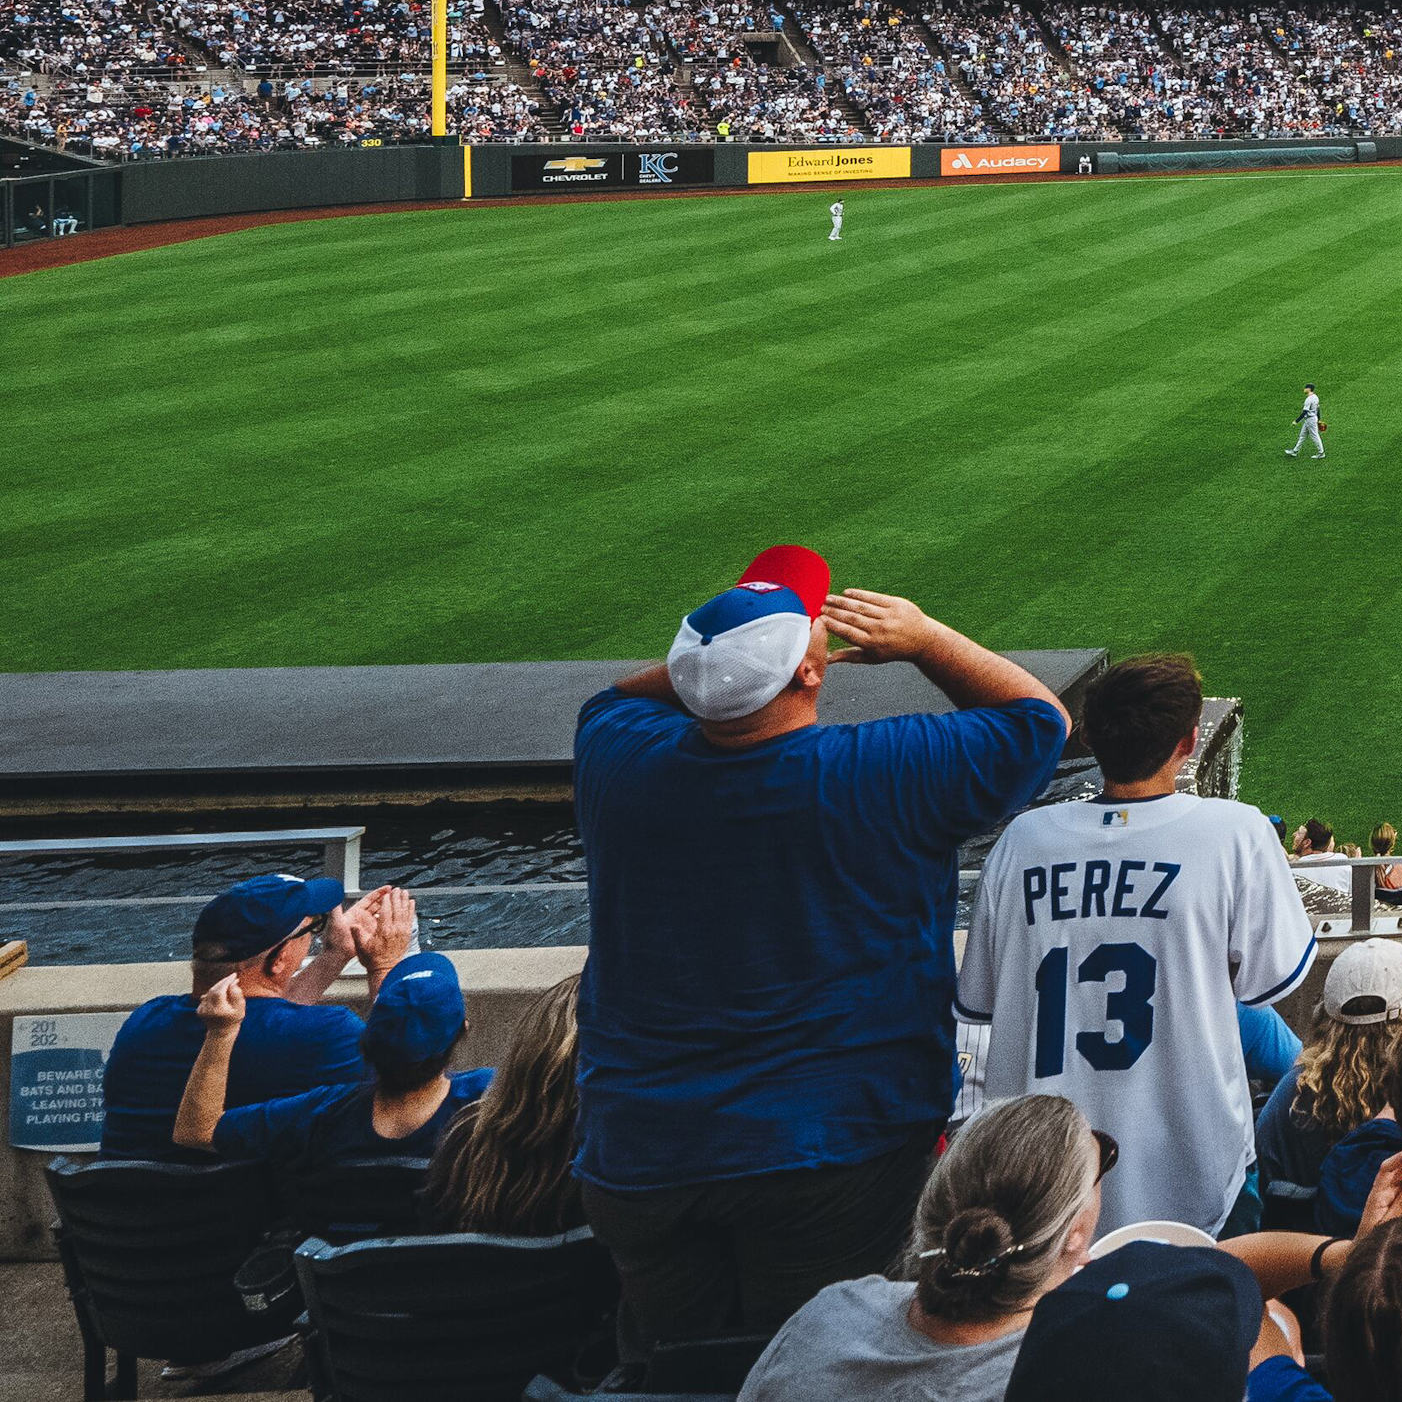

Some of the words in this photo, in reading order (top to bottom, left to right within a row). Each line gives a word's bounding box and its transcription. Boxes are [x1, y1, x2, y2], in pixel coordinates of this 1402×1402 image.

[361, 138, 381, 148] 330
[638, 152, 679, 183] KC
[788, 155, 834, 168] Edward
[836, 155, 873, 167] Jones
[977, 157, 1049, 169] Audacy
[543, 173, 609, 183] CHEVROLET
[1023, 859, 1182, 926] PEREZ
[1035, 942, 1158, 1079] 13
[31, 1020, 56, 1034] 201
[31, 1033, 58, 1047] 202
[37, 1069, 91, 1082] BEWARE
[20, 1085, 54, 1097] BATS
[56, 1084, 84, 1095] AND
[31, 1098, 87, 1110] LEAVING
[26, 1112, 81, 1125] PLAYING
